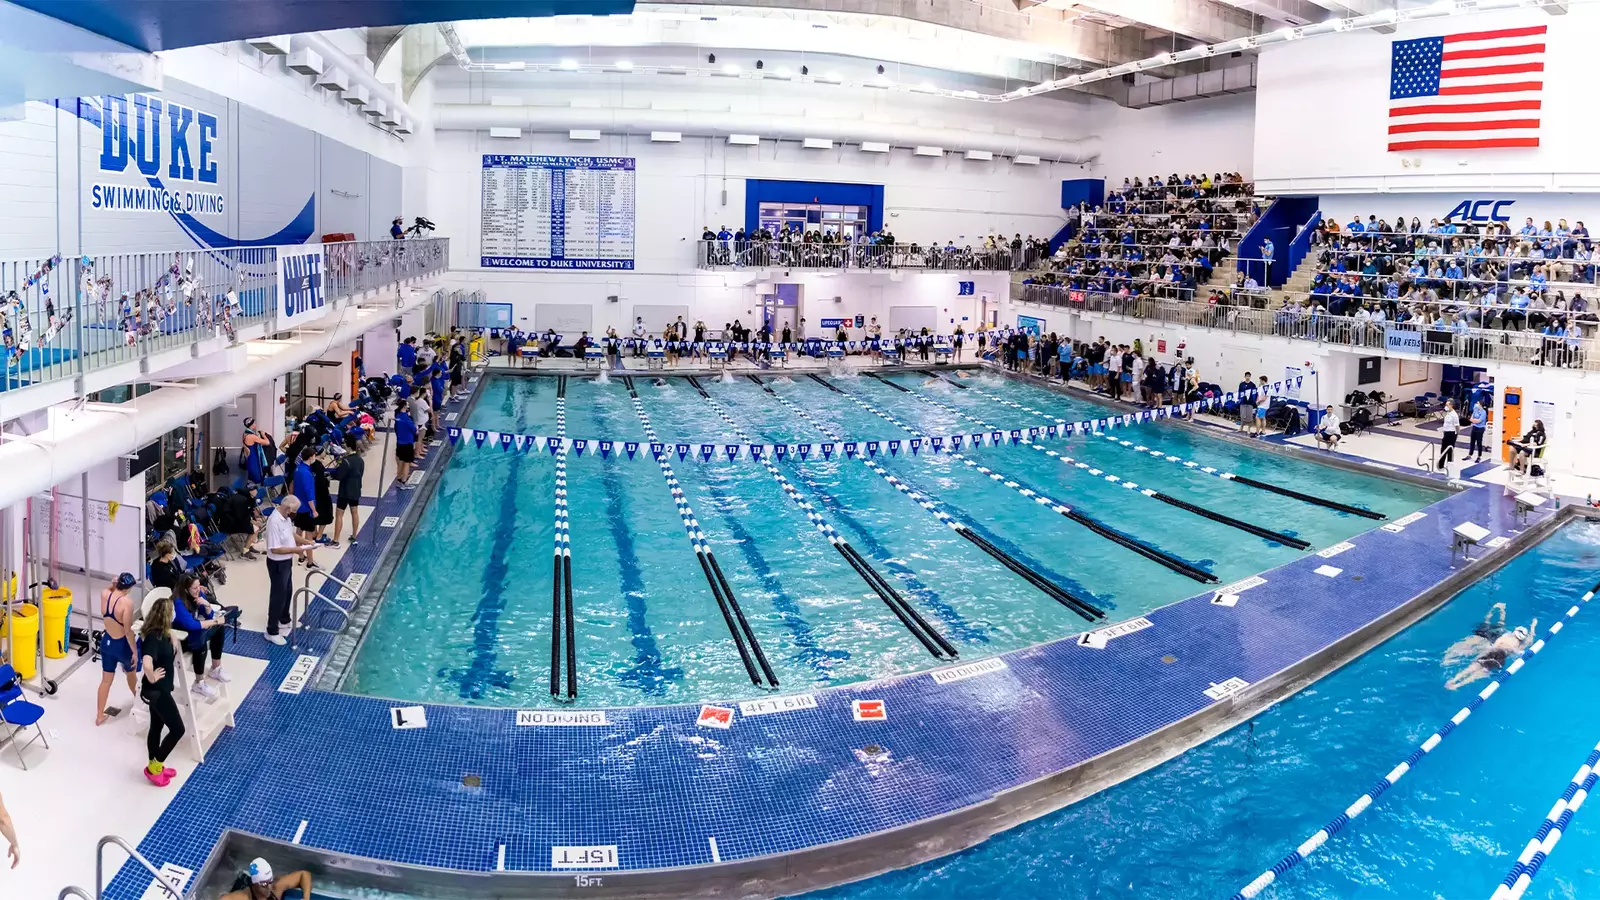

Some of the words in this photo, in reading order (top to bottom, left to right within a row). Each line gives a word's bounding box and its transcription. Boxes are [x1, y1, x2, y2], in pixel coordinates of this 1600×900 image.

[99, 93, 218, 184] DUKE
[92, 184, 170, 212] SWIMMING
[173, 192, 182, 212] &
[186, 193, 223, 213] DIVING
[1442, 200, 1516, 221] ACC
[491, 258, 534, 266] WELCOME
[294, 657, 313, 676] 4FT
[936, 671, 957, 682] NO
[958, 660, 1002, 677] DIVING
[746, 701, 780, 713] 4FT
[784, 696, 812, 708] 6IN
[521, 714, 542, 722] NO
[547, 714, 602, 723] DIVING
[558, 850, 612, 864] 15FT
[574, 875, 603, 887] 15FT.
